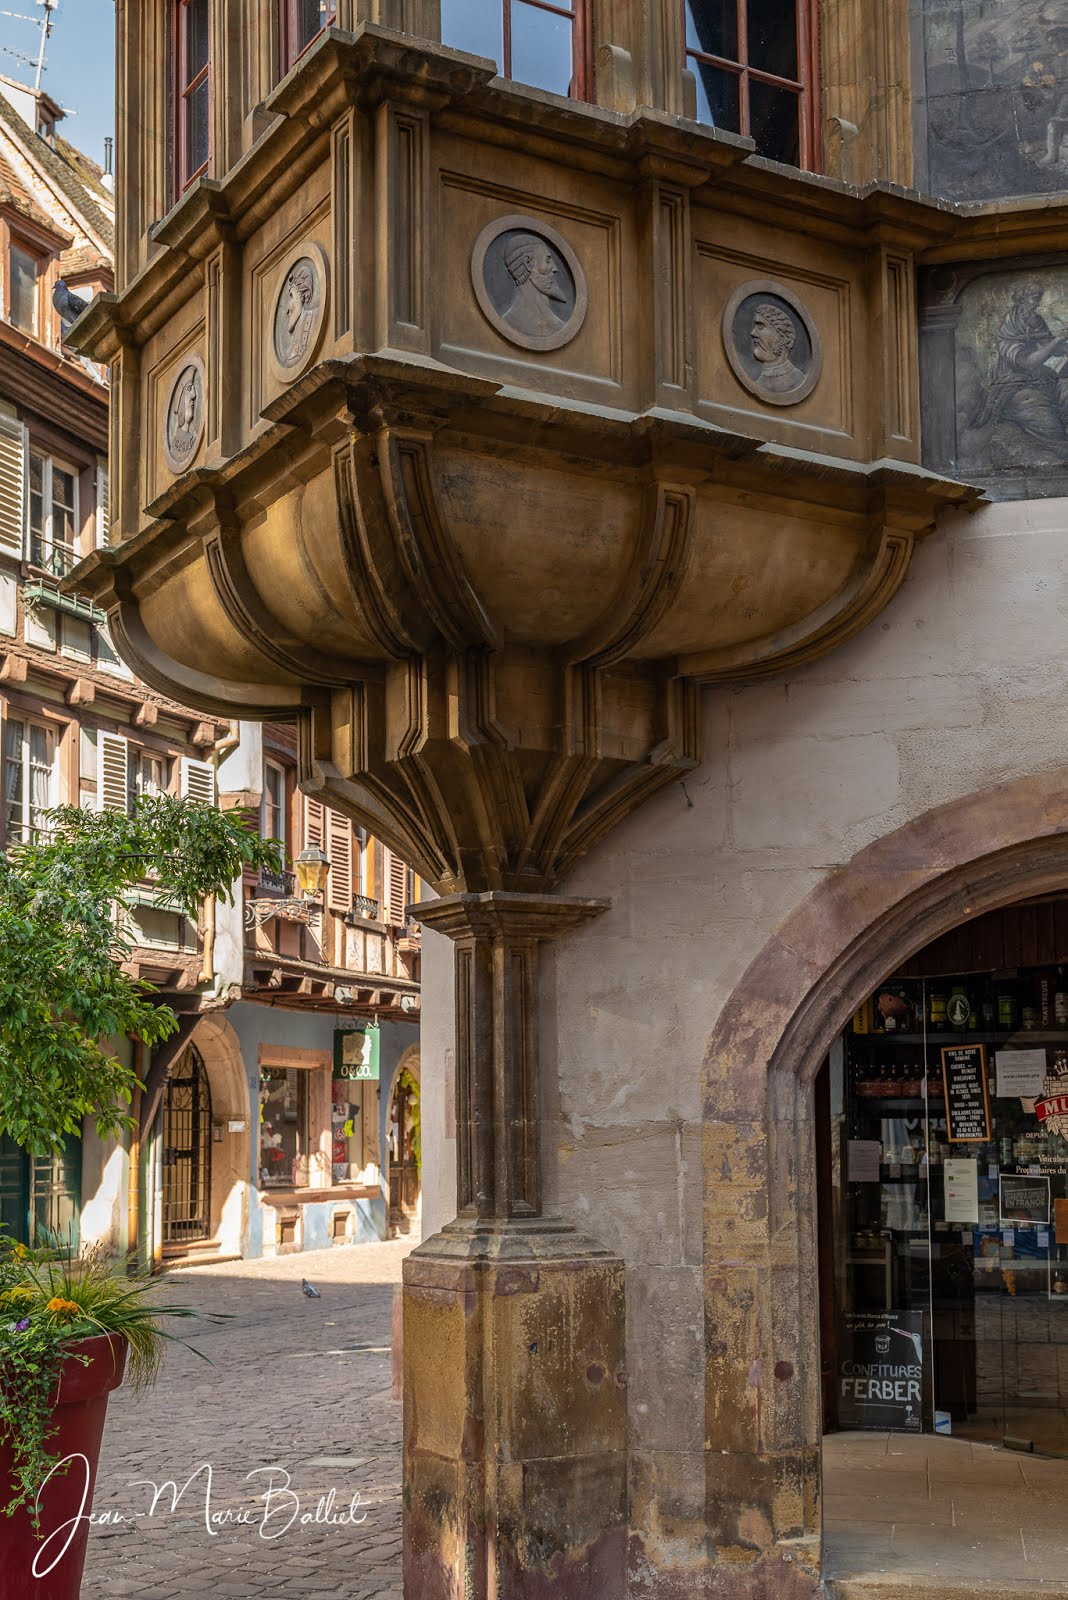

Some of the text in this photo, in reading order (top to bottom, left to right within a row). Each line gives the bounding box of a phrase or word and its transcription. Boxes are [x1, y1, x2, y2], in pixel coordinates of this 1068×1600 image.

[1041, 979, 1049, 1026] CHARTREUSE
[341, 1065, 372, 1077] O&CO.
[1016, 1165, 1067, 1175] Propriétaires du
[841, 1360, 922, 1379] CONFITURES
[841, 1378, 922, 1402] FERBER
